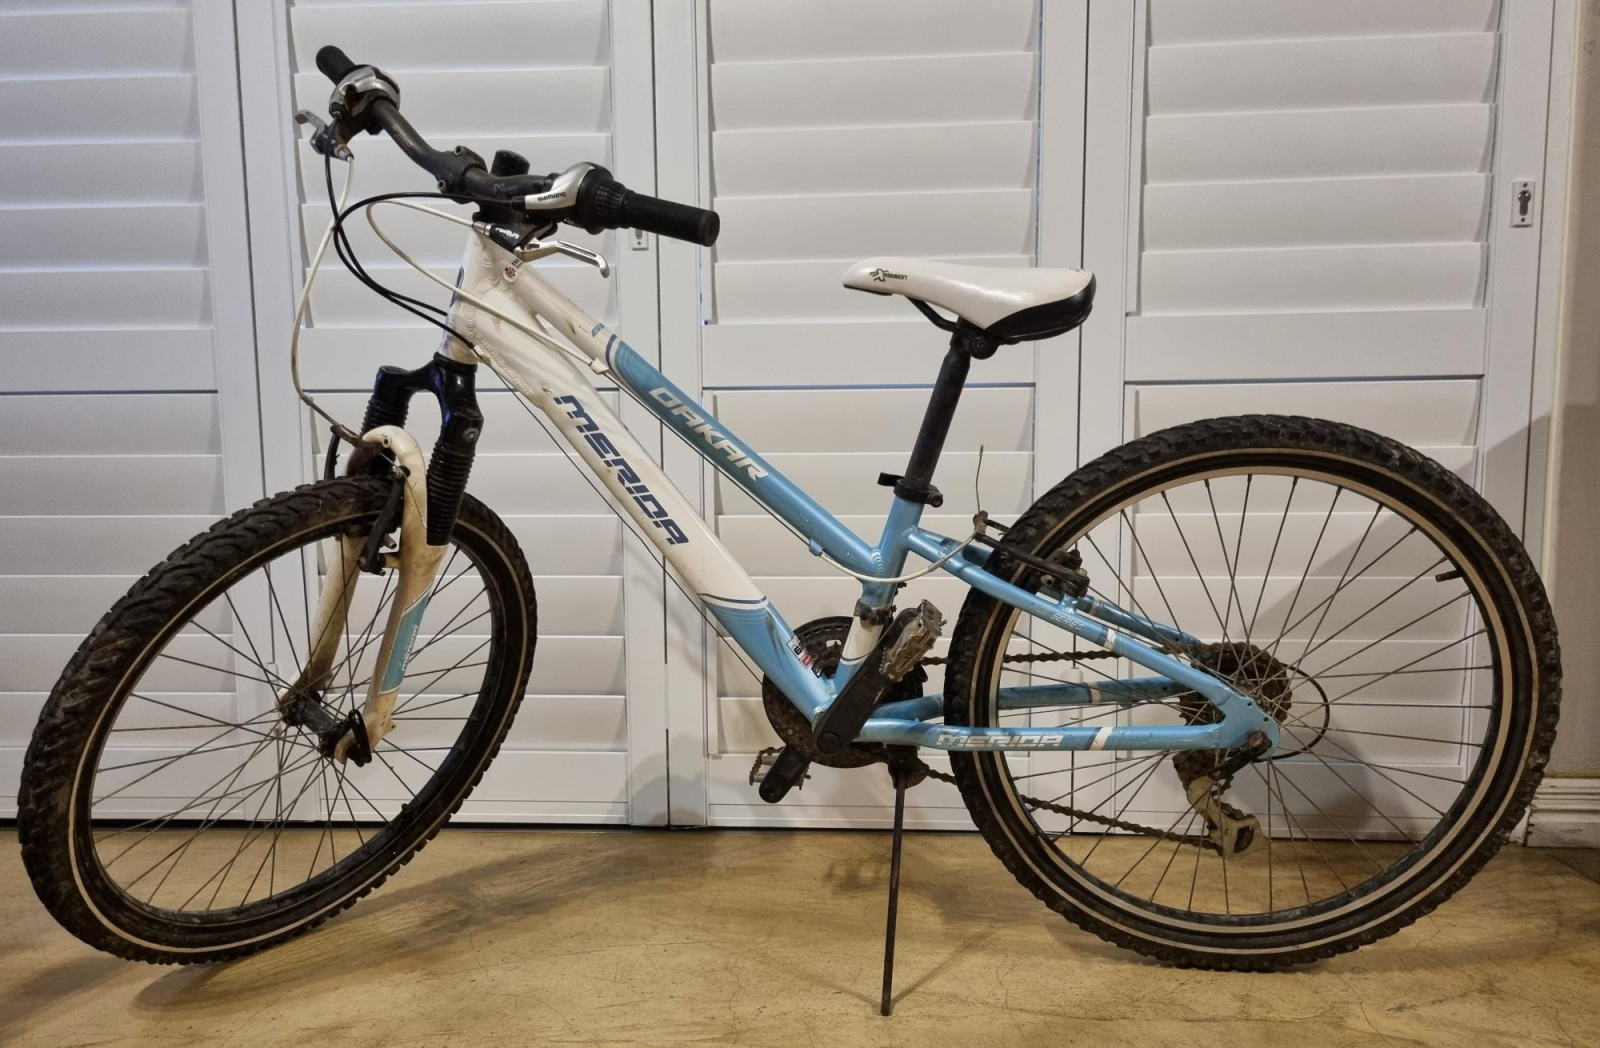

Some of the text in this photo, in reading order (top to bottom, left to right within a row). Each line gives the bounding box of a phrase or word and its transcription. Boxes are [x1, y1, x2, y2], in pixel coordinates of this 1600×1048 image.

[537, 191, 567, 202] SHIMANO
[649, 387, 768, 481] DAKAR
[553, 395, 689, 545] MERIDA
[936, 733, 1063, 747] MERIDA
